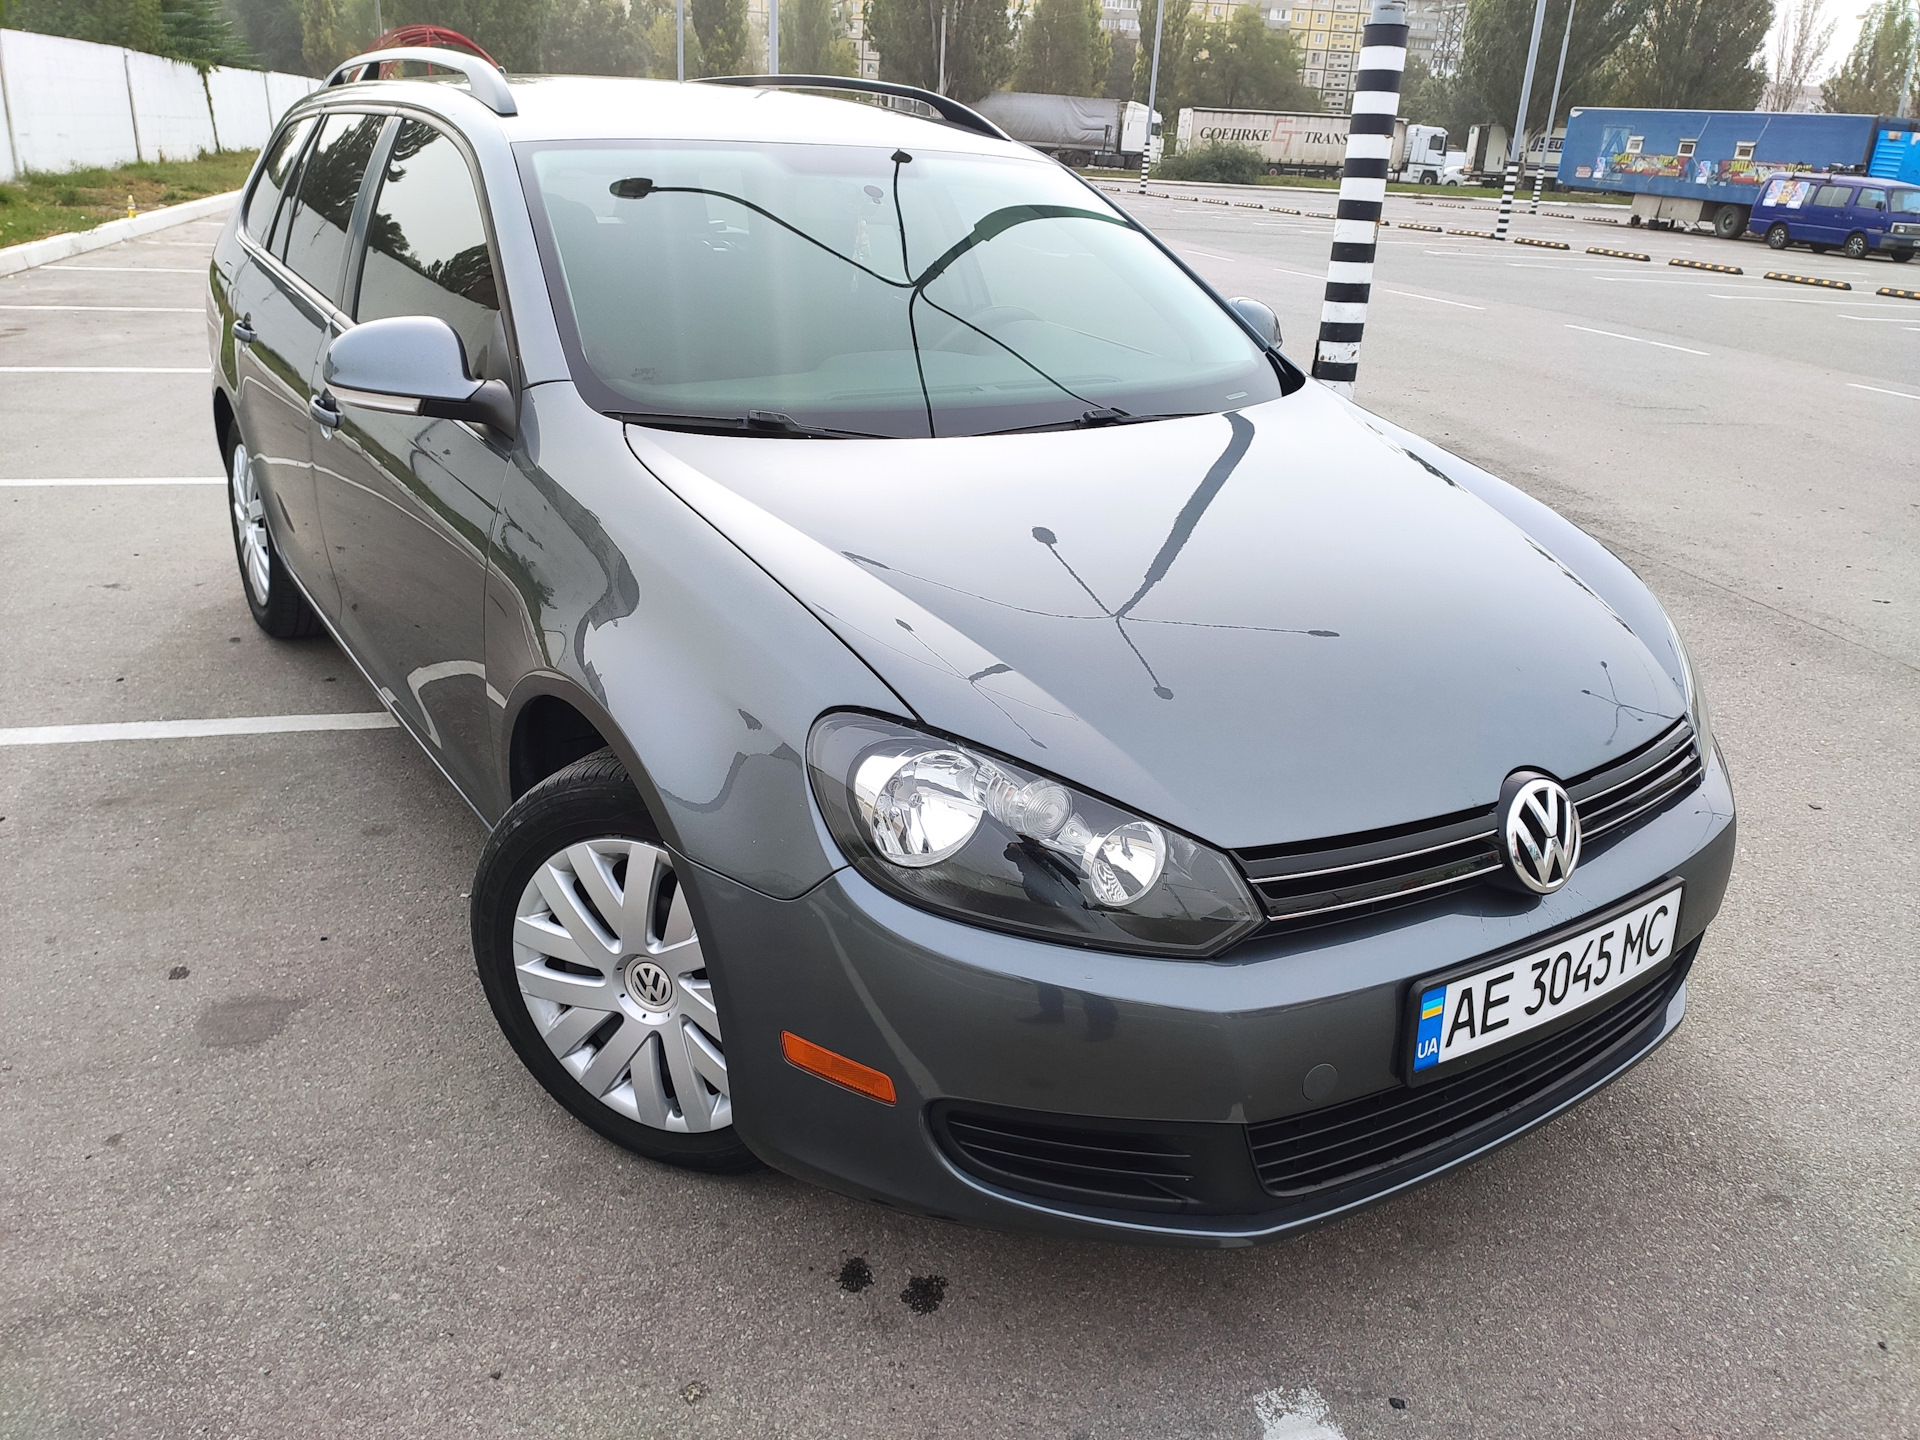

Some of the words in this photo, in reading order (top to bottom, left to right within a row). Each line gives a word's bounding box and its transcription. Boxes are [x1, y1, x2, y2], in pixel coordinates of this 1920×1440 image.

[1200, 126, 1272, 142] GOEHRKE
[1444, 971, 1515, 1049] AE
[1523, 929, 1615, 1016] 3045
[1619, 904, 1669, 976] MC
[1417, 1036, 1438, 1059] UA
